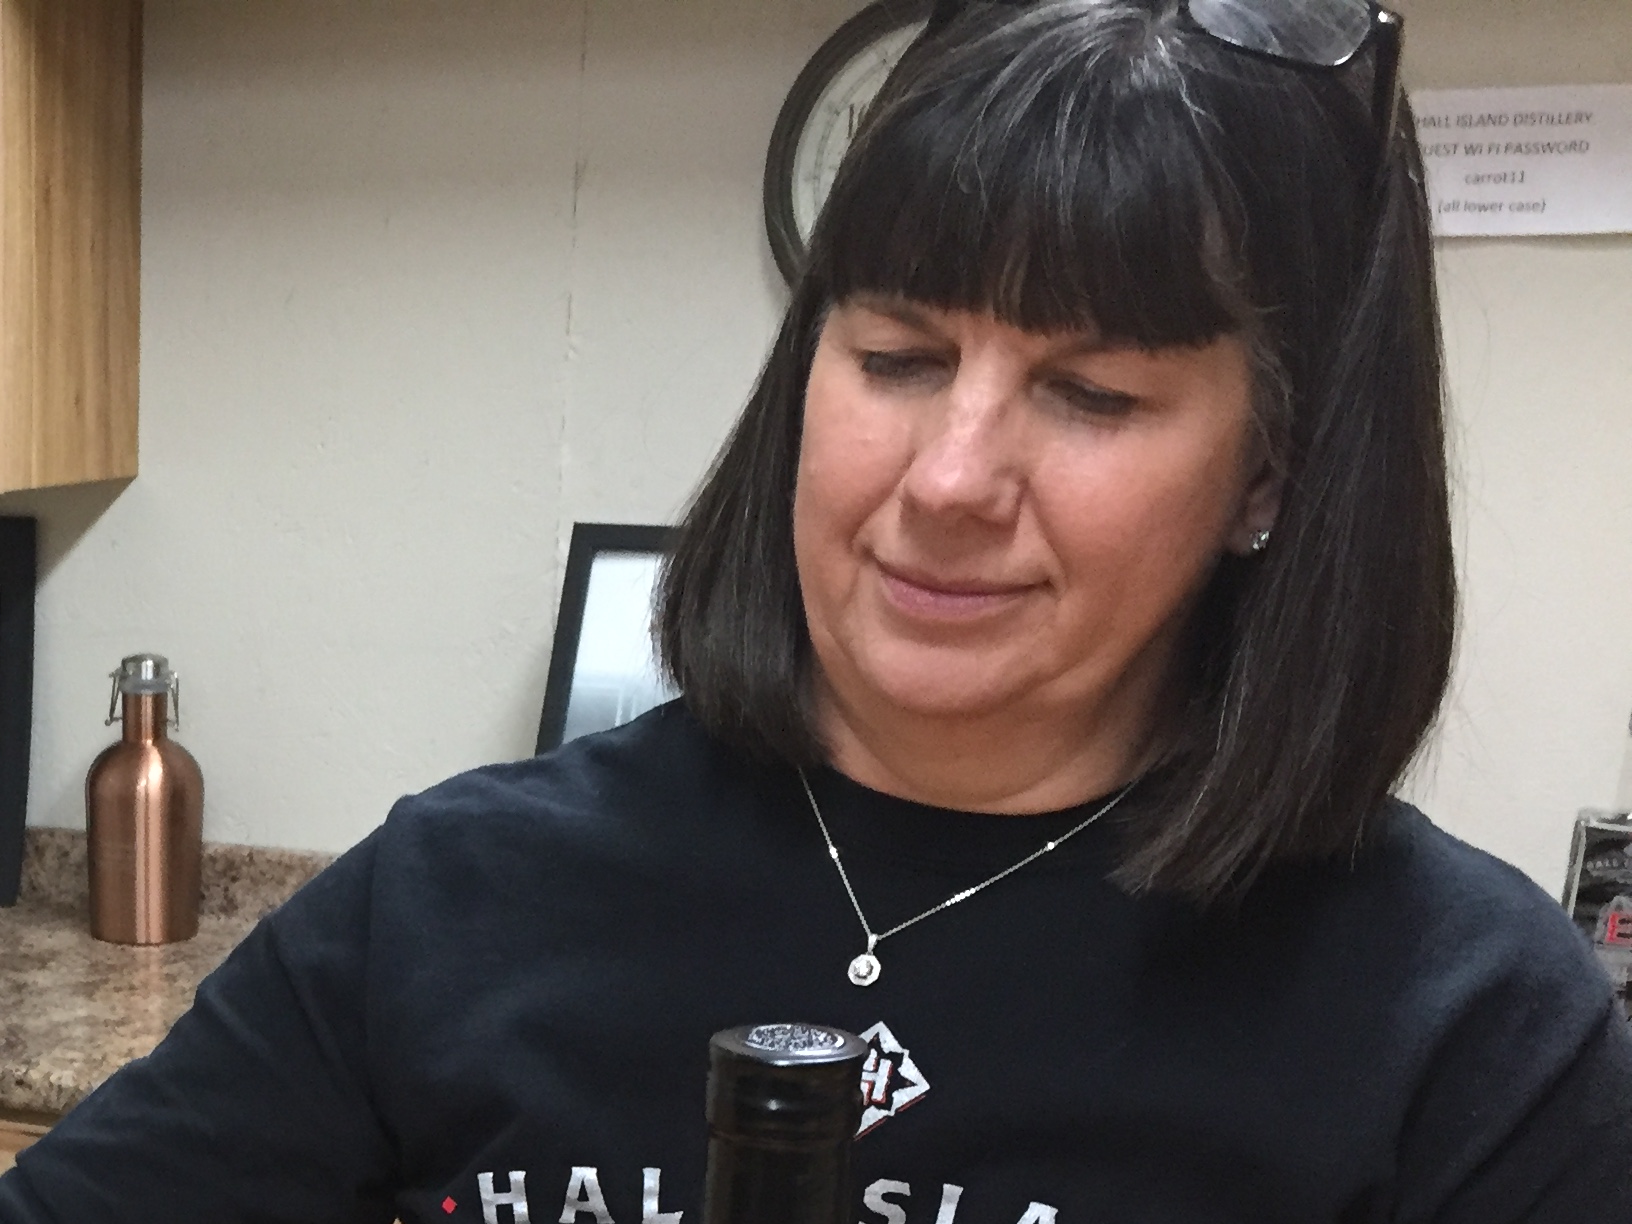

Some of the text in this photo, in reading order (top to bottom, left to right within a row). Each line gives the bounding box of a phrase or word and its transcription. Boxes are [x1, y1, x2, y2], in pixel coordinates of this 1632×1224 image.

[1456, 113, 1510, 129] ISLAND
[1513, 111, 1594, 127] DISTILLERY
[1422, 143, 1460, 157] UEST
[1504, 139, 1590, 155] PASSWORD
[1464, 199, 1504, 213] lower
